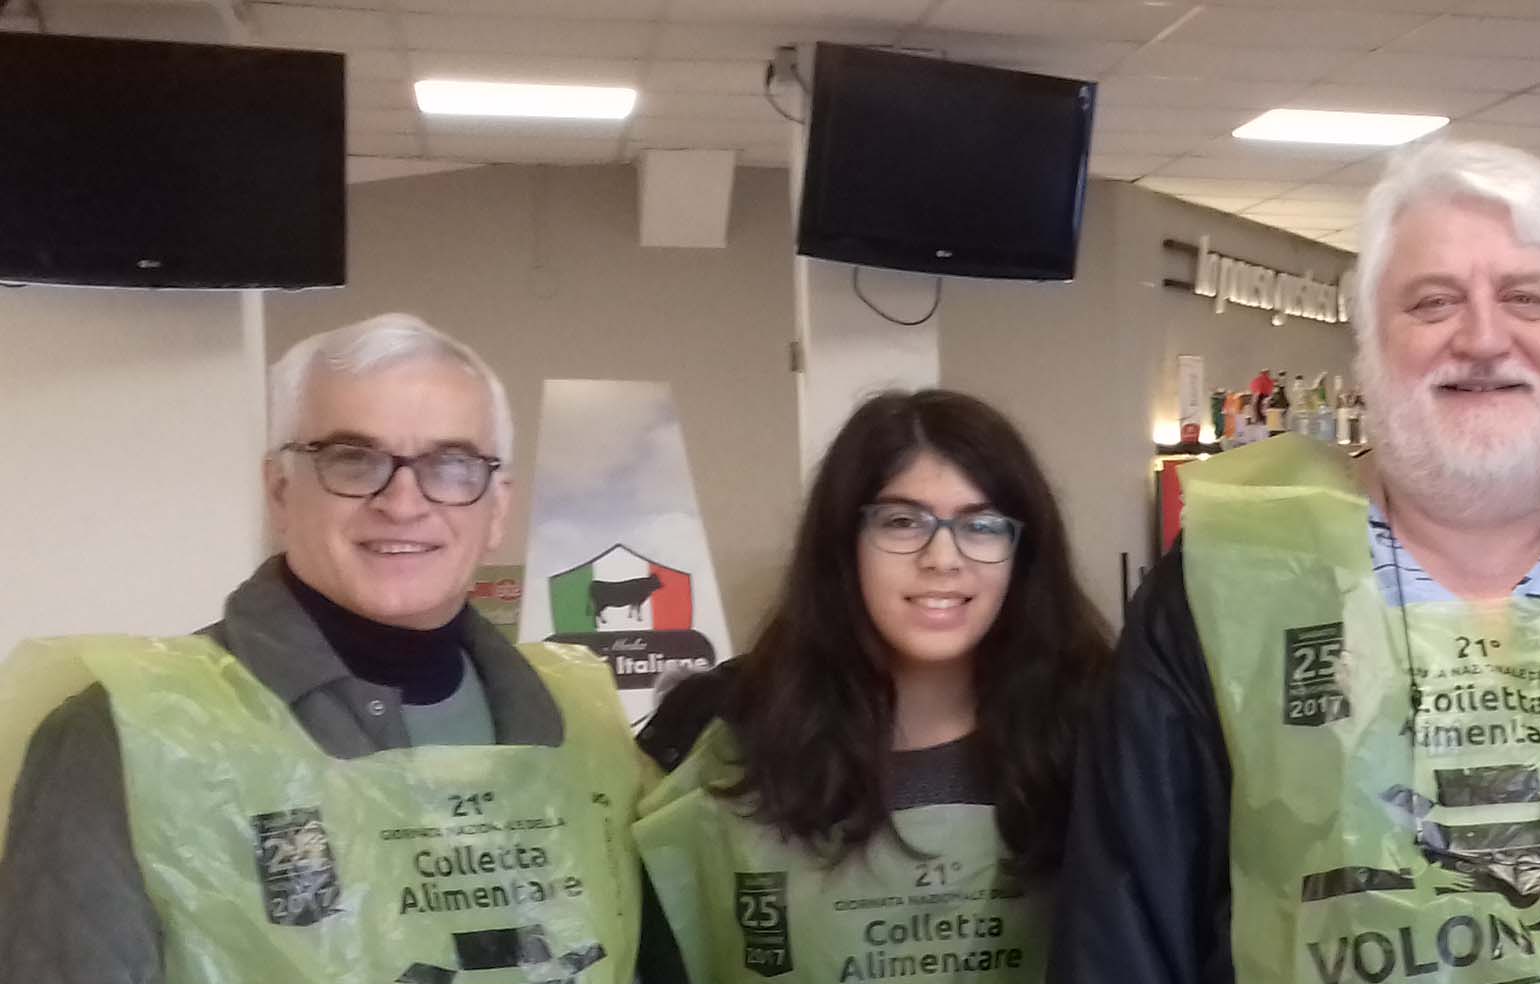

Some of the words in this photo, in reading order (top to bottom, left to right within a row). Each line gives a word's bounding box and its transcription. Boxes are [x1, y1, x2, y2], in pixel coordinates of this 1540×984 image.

[1292, 643, 1341, 681] 25
[1289, 695, 1345, 721] 2017
[448, 791, 495, 817] 21°
[414, 844, 548, 878] Colletta
[739, 895, 780, 929] 25
